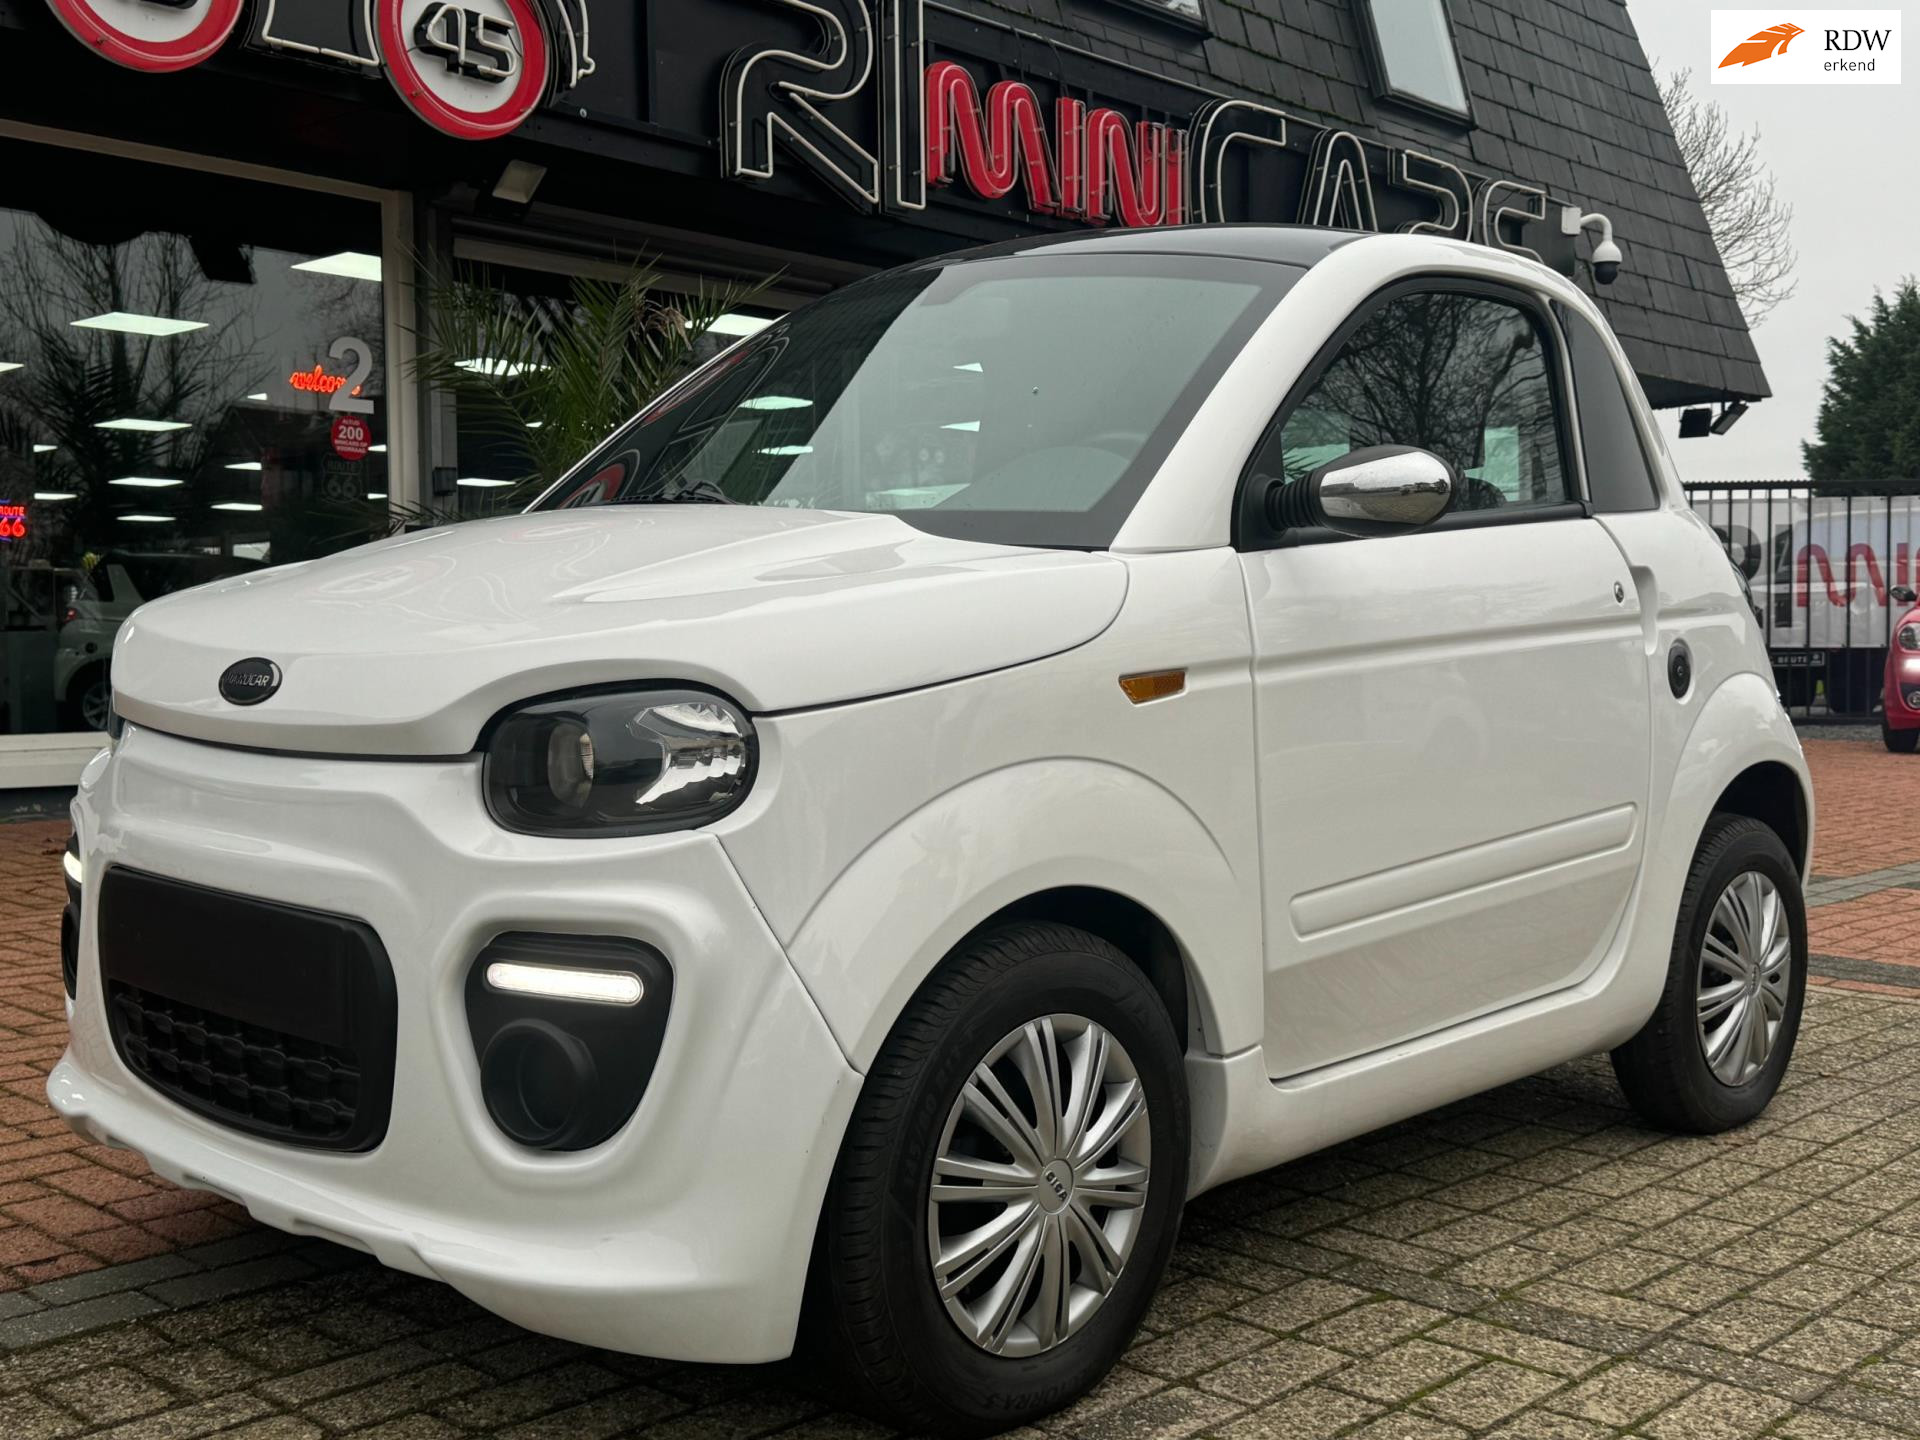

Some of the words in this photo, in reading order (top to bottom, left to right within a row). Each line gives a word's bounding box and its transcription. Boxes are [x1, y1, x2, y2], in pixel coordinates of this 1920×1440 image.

[415, 3, 518, 83] 45
[289, 364, 362, 395] welco
[329, 336, 374, 414] 2
[338, 425, 364, 441] 200
[0, 516, 25, 537] 66
[1045, 1170, 1069, 1201] GIGA
